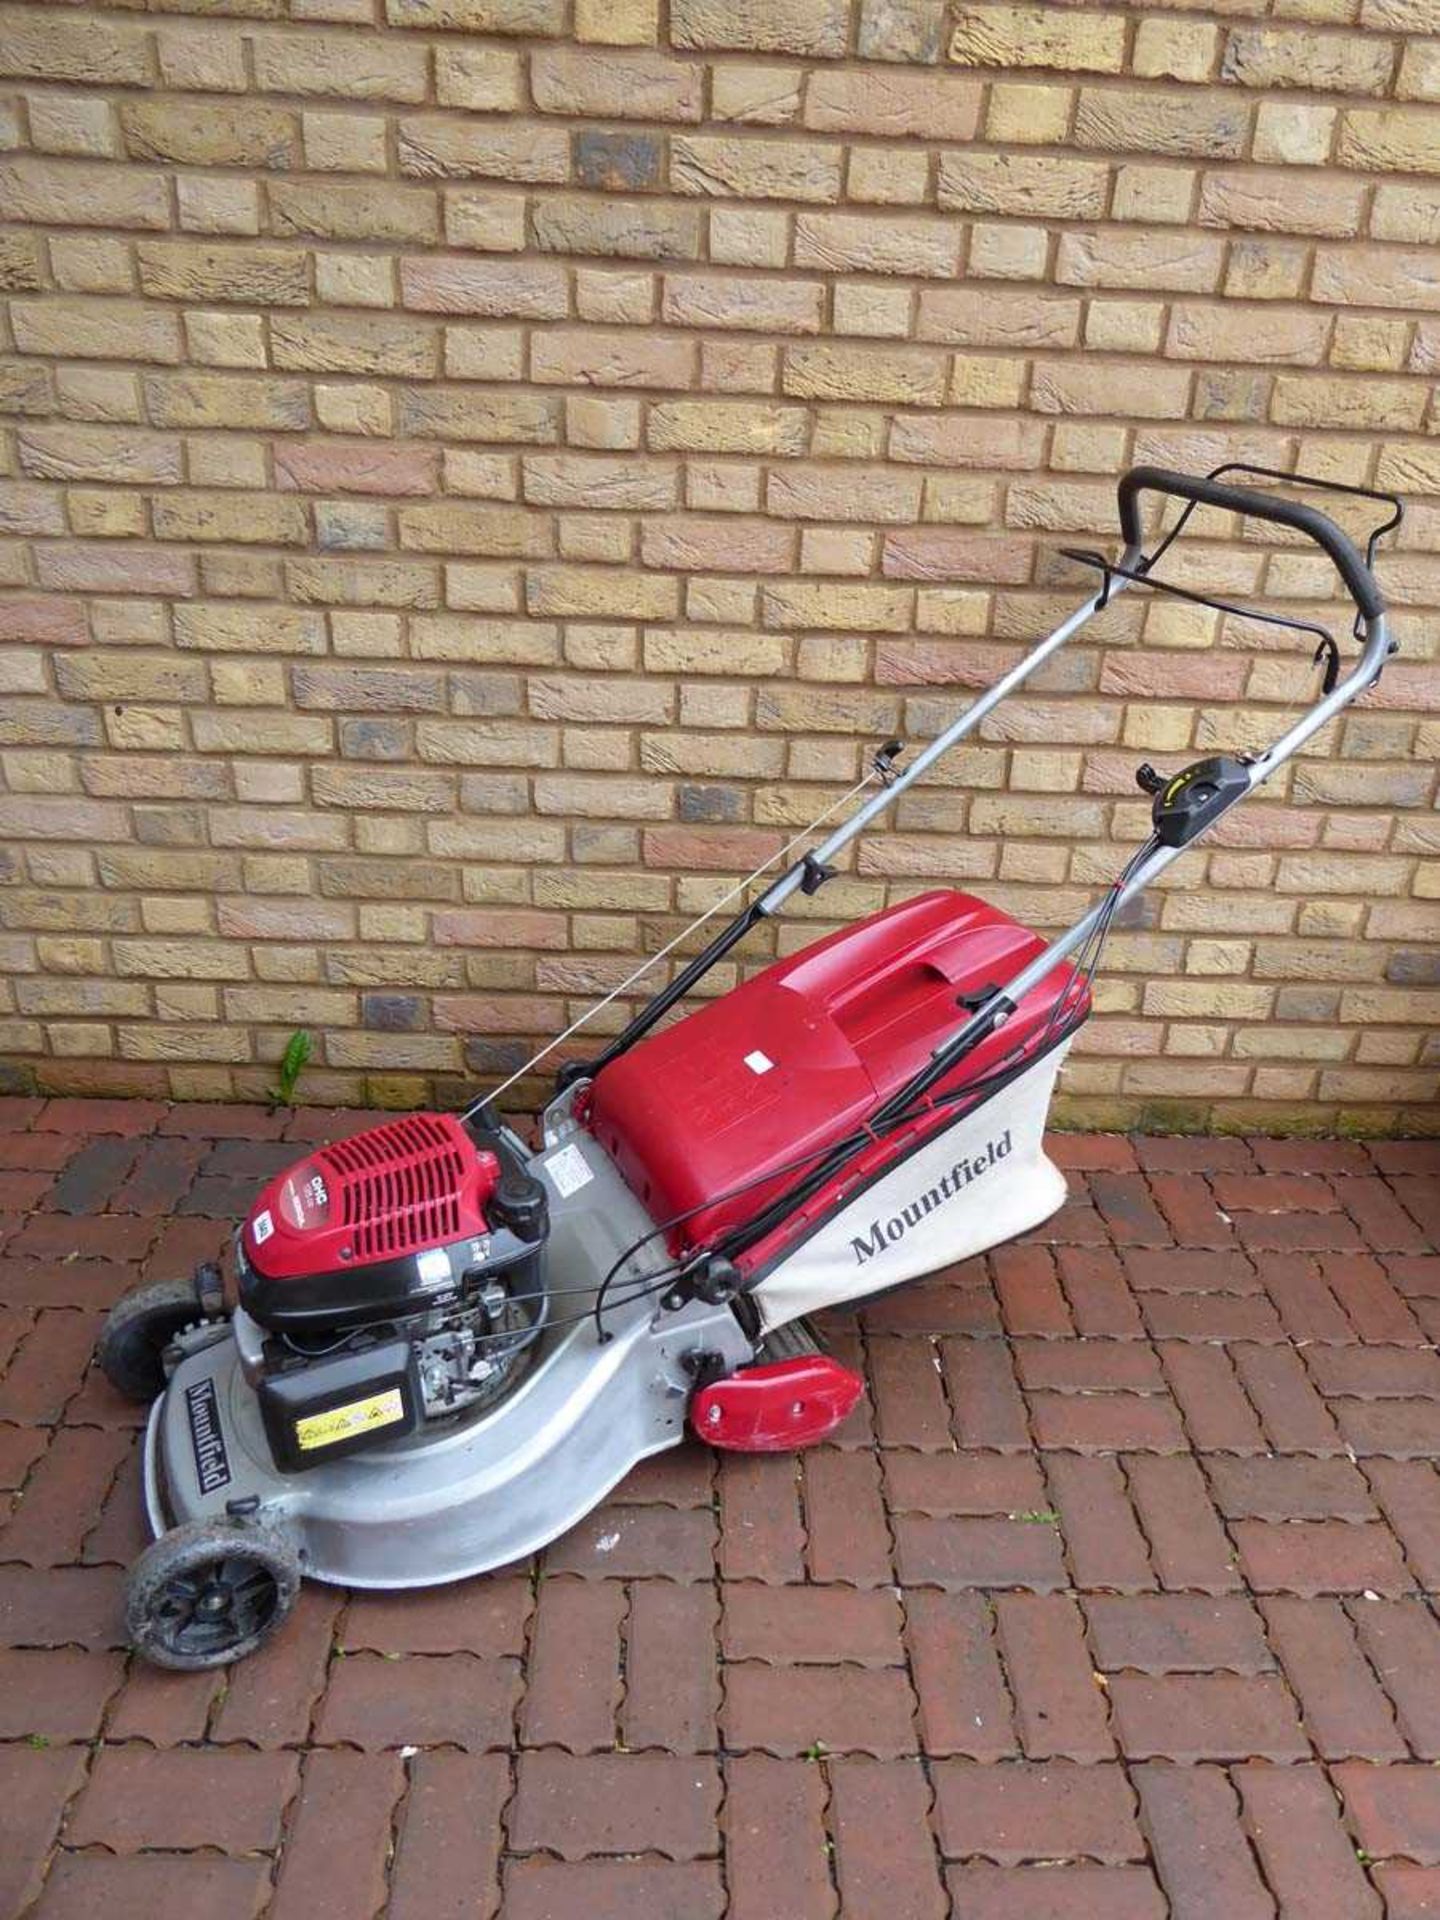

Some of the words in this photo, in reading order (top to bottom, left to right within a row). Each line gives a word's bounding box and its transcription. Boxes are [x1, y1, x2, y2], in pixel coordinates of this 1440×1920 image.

[311, 1175, 327, 1205] OHC
[850, 1130, 1012, 1265] Mountfield
[189, 1380, 228, 1491] Mountfield
